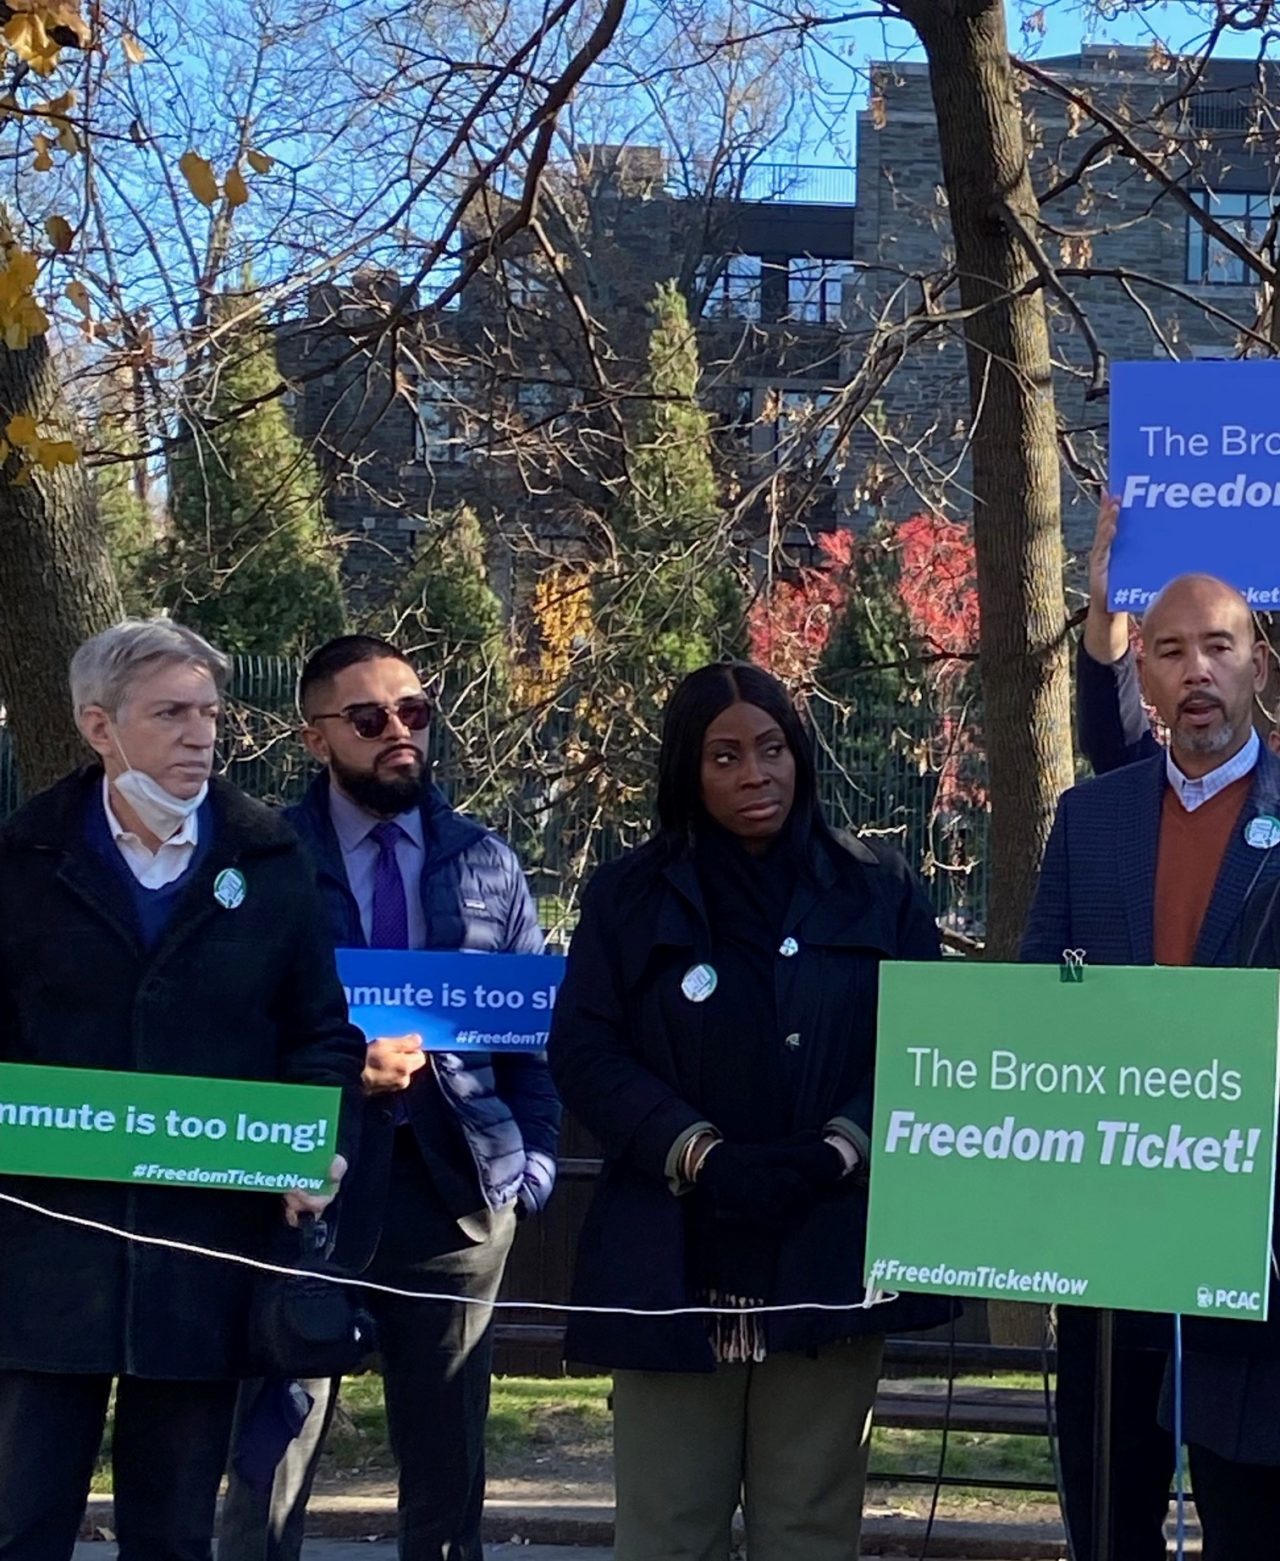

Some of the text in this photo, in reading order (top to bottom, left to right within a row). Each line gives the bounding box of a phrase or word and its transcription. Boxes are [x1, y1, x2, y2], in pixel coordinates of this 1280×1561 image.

[1139, 426, 1209, 457] The
[441, 982, 467, 1008] is
[473, 985, 524, 1009] too
[532, 985, 557, 1010] sl
[455, 1030, 549, 1045] #FreedomTi
[906, 1047, 1242, 1101] The Bronx needs
[125, 1105, 156, 1135] is
[164, 1109, 227, 1140] too
[236, 1113, 328, 1153] long!
[884, 1110, 1262, 1173] Freedom Ticket!
[132, 1164, 324, 1190] #FreedomTicketNow
[870, 1259, 1088, 1296] #FreedomTicketNow
[1215, 1289, 1261, 1311] PCAC
